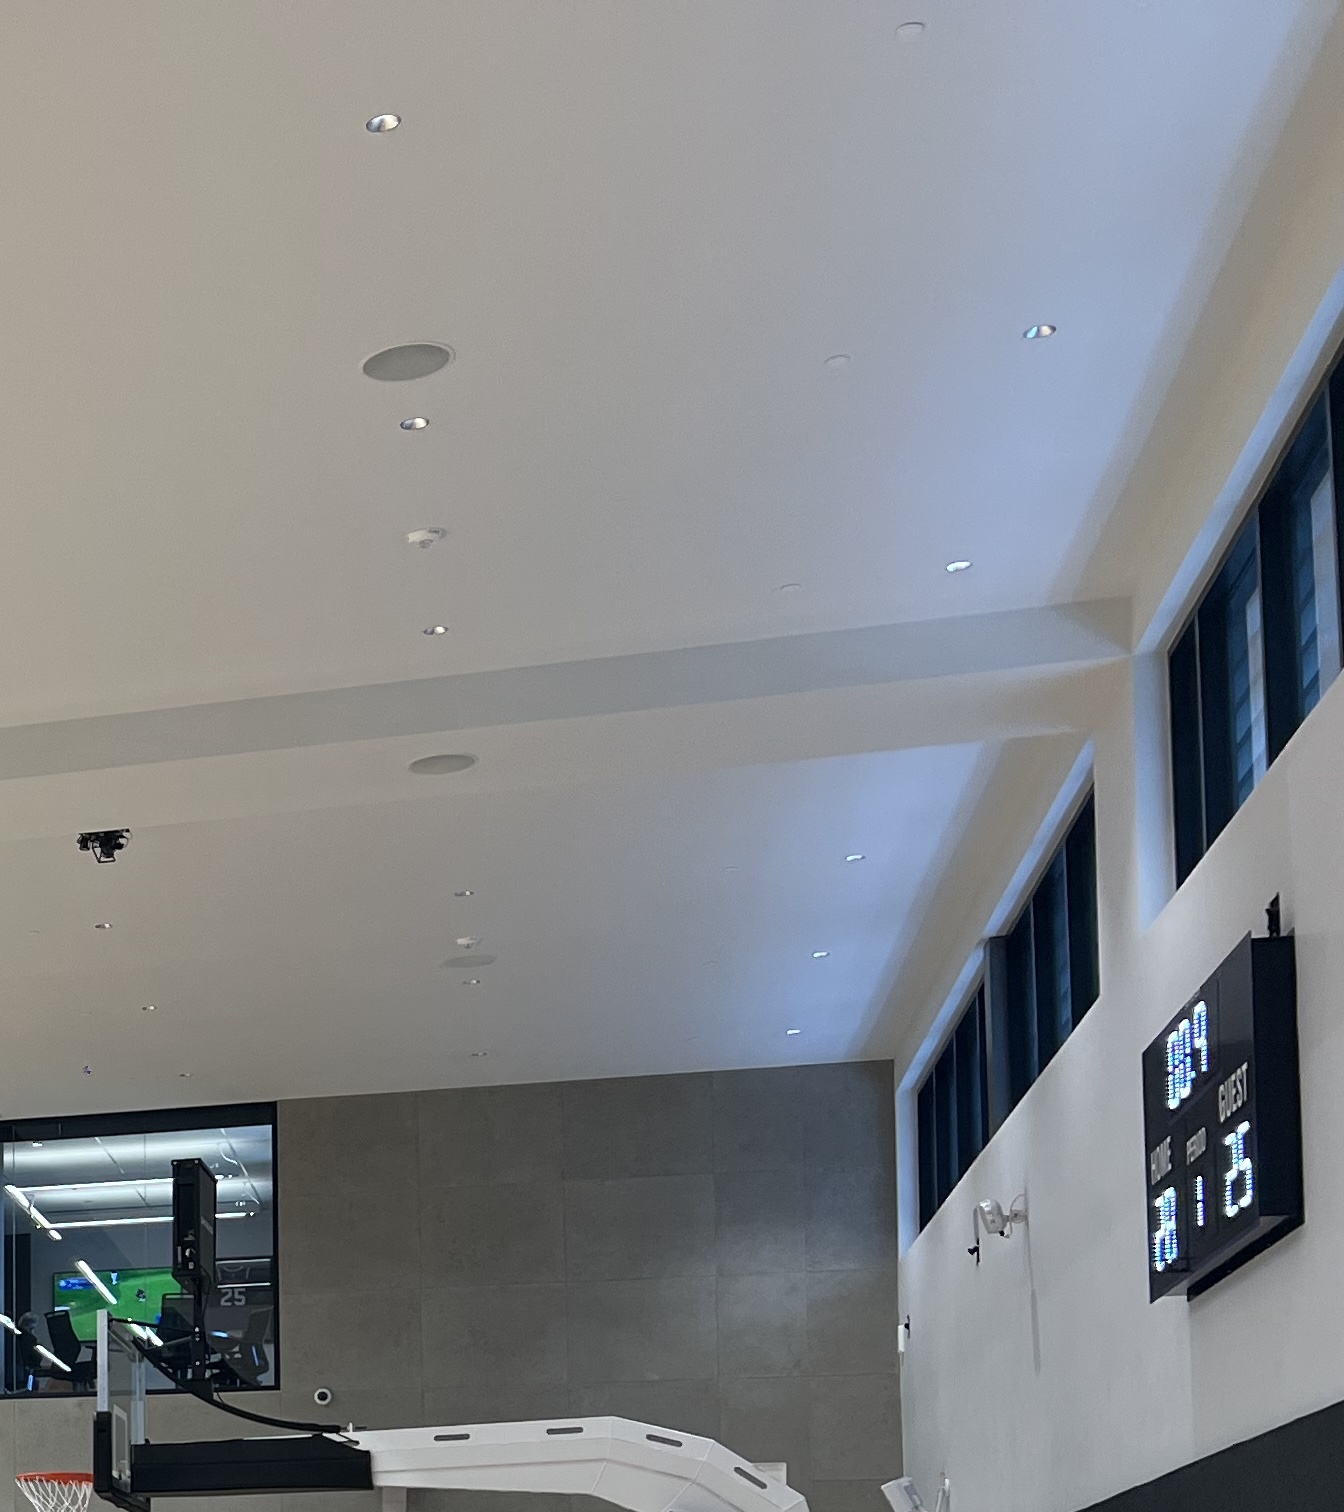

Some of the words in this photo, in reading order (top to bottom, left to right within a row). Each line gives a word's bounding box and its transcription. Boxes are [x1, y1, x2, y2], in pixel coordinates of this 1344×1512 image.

[1218, 1061, 1248, 1123] GUEST
[1150, 1136, 1172, 1185] HOME
[1196, 1176, 1205, 1227] 1
[220, 1288, 246, 1306] 25
